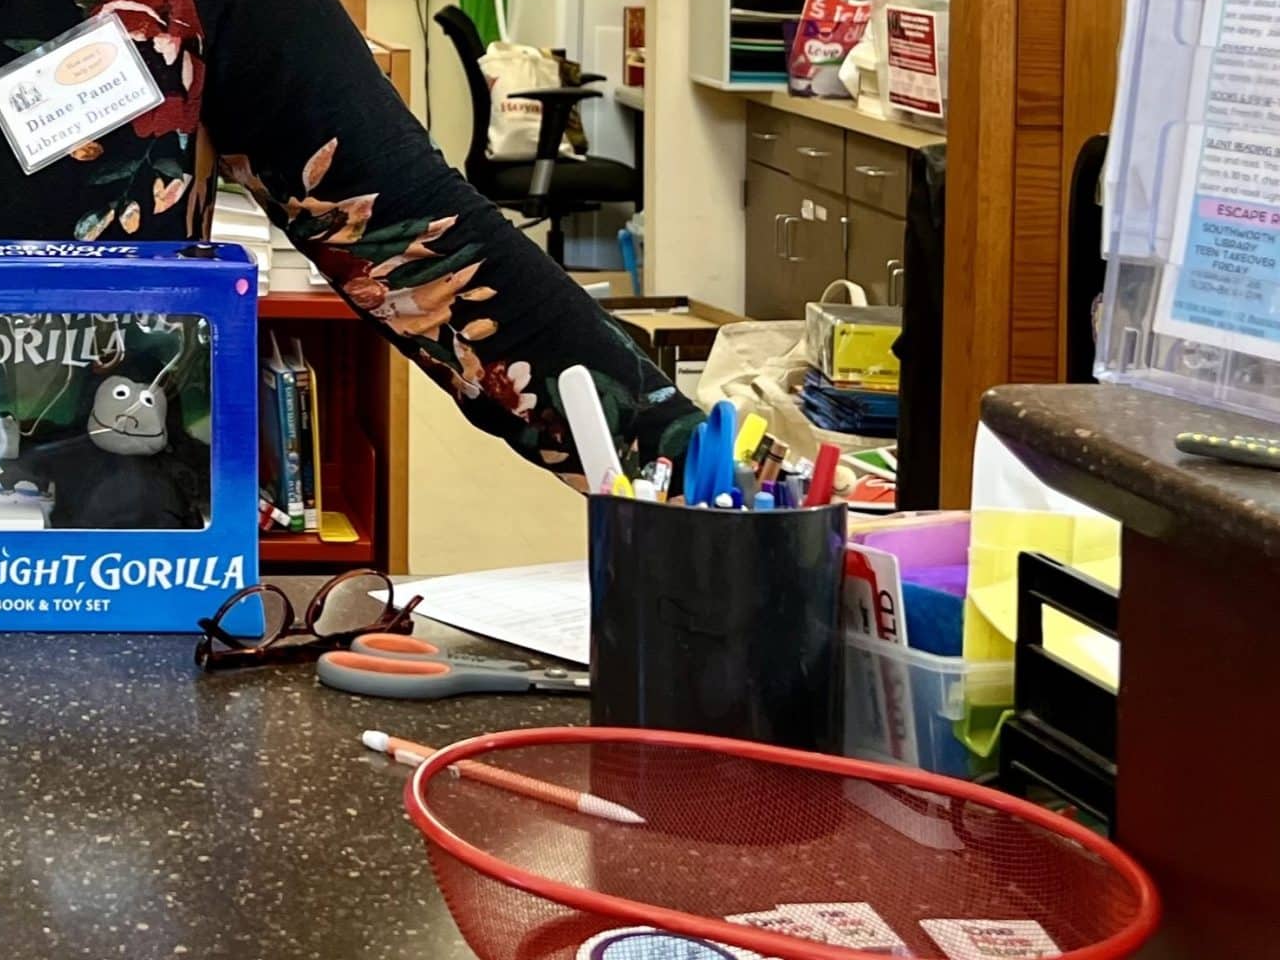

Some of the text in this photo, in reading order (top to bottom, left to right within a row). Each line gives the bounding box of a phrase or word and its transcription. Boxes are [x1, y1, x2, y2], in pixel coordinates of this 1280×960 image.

[26, 71, 128, 133] Diane Pamel
[26, 86, 147, 156] Library Director
[1217, 204, 1267, 223] ESCAPE
[1202, 223, 1276, 242] SOUTHWORTH
[1214, 237, 1257, 252] LIBRARY
[1195, 244, 1276, 268] TEEN TAKEOVER
[1212, 260, 1249, 274] FRIDAY
[90, 553, 245, 591] GORILLA
[39, 599, 49, 611] &
[53, 598, 82, 611] TOY
[85, 598, 111, 611] SET
